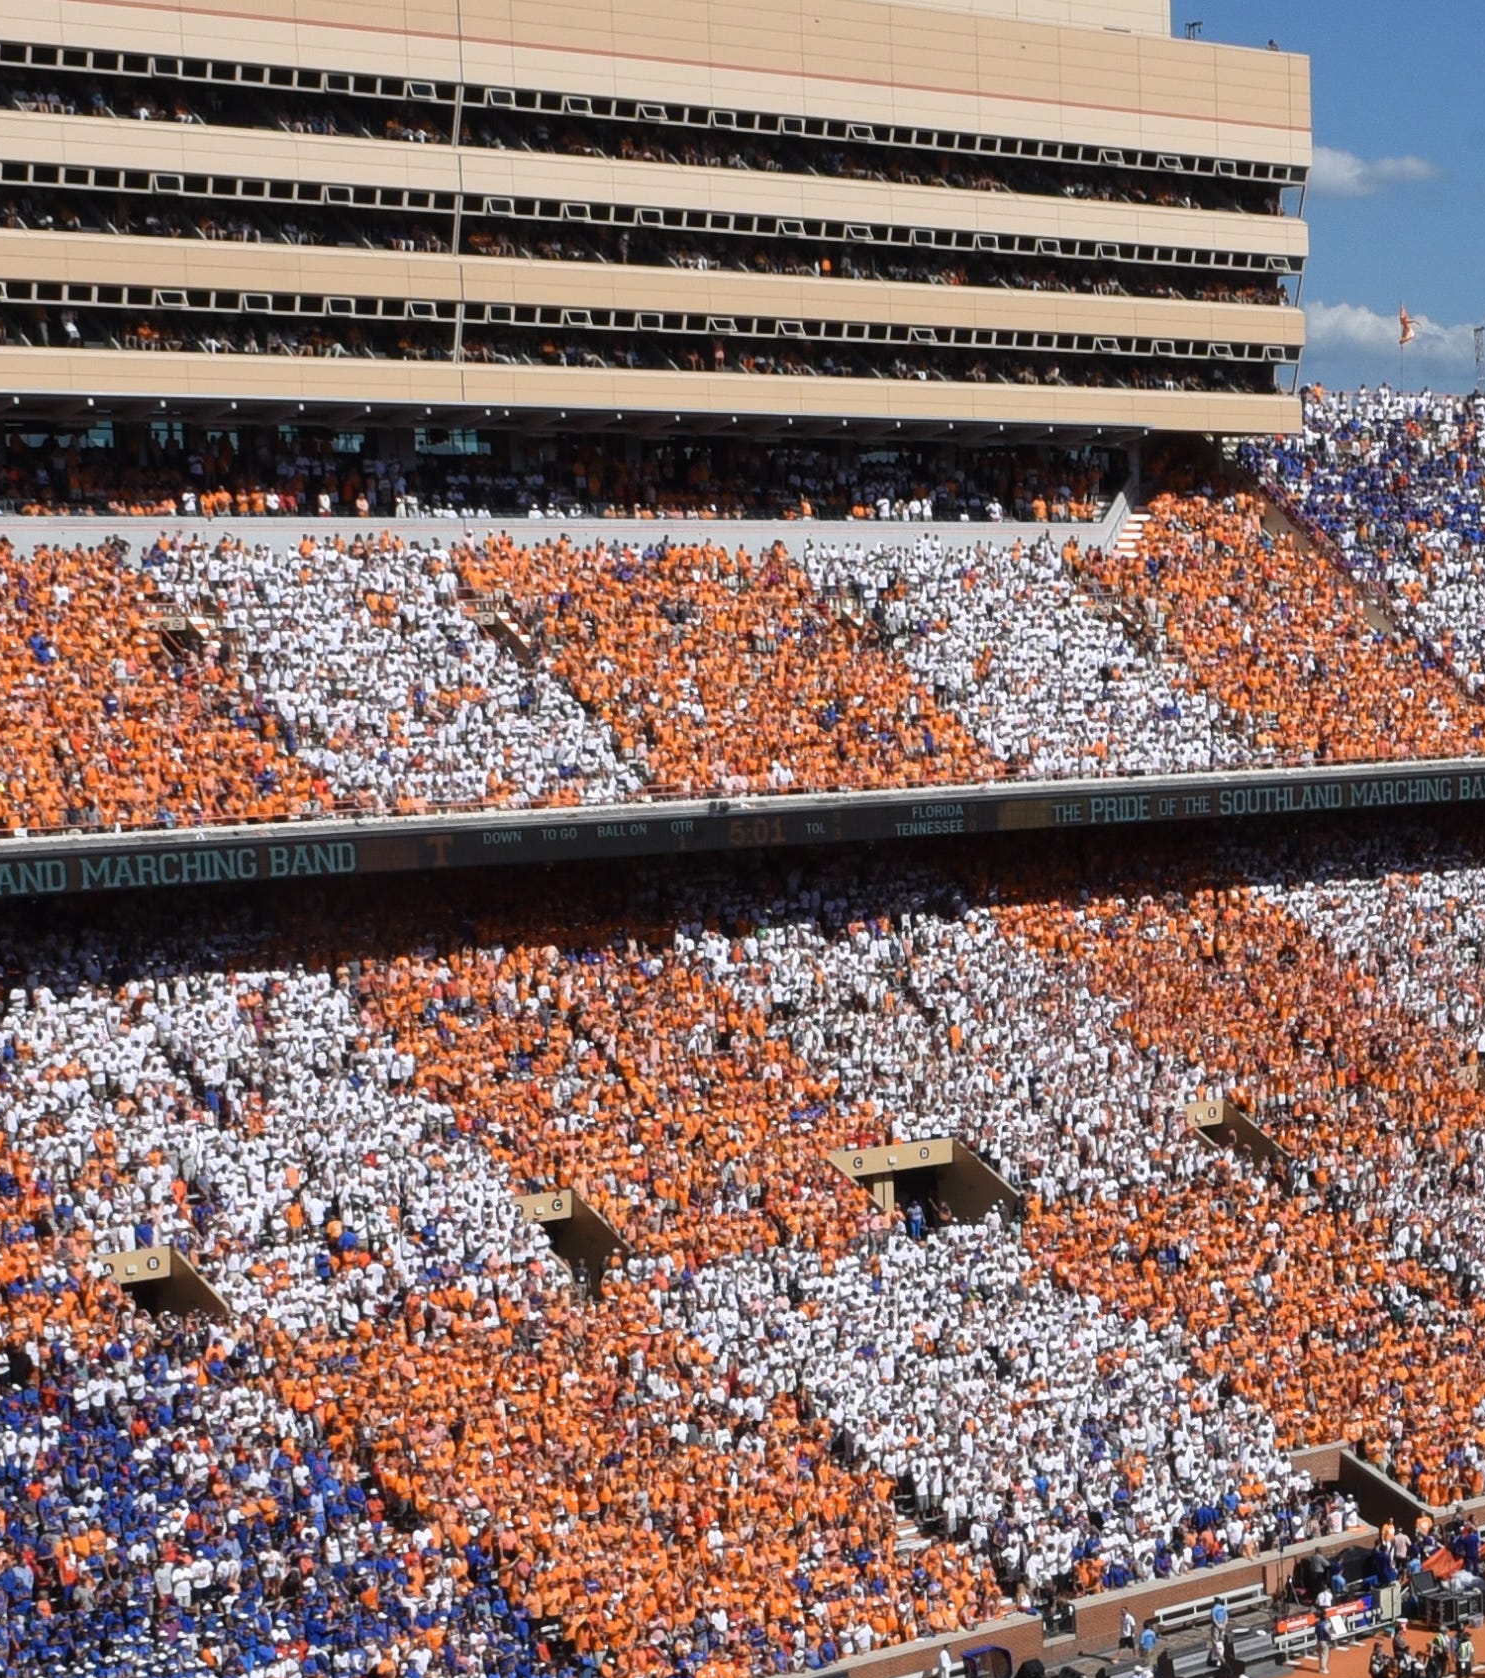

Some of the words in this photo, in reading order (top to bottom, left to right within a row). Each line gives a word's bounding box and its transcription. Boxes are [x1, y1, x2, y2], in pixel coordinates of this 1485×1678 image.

[1052, 803, 1082, 824] THE
[1090, 795, 1151, 824] PRIDE
[1158, 798, 1176, 816] OF
[1184, 795, 1211, 815] THE
[1219, 784, 1342, 815] SOUTHLAND
[1350, 777, 1452, 807] MARCHING
[912, 804, 964, 819] FLORIDA
[541, 829, 556, 841] TO
[560, 828, 577, 840] GO
[597, 824, 627, 838] BALL
[629, 823, 648, 836] ON
[670, 820, 694, 834] QTR
[805, 822, 826, 834] TOL
[895, 821, 965, 838] TENNESSEE
[482, 831, 522, 845] DOWN
[80, 847, 257, 890] MARCHING
[269, 842, 355, 878] BAND
